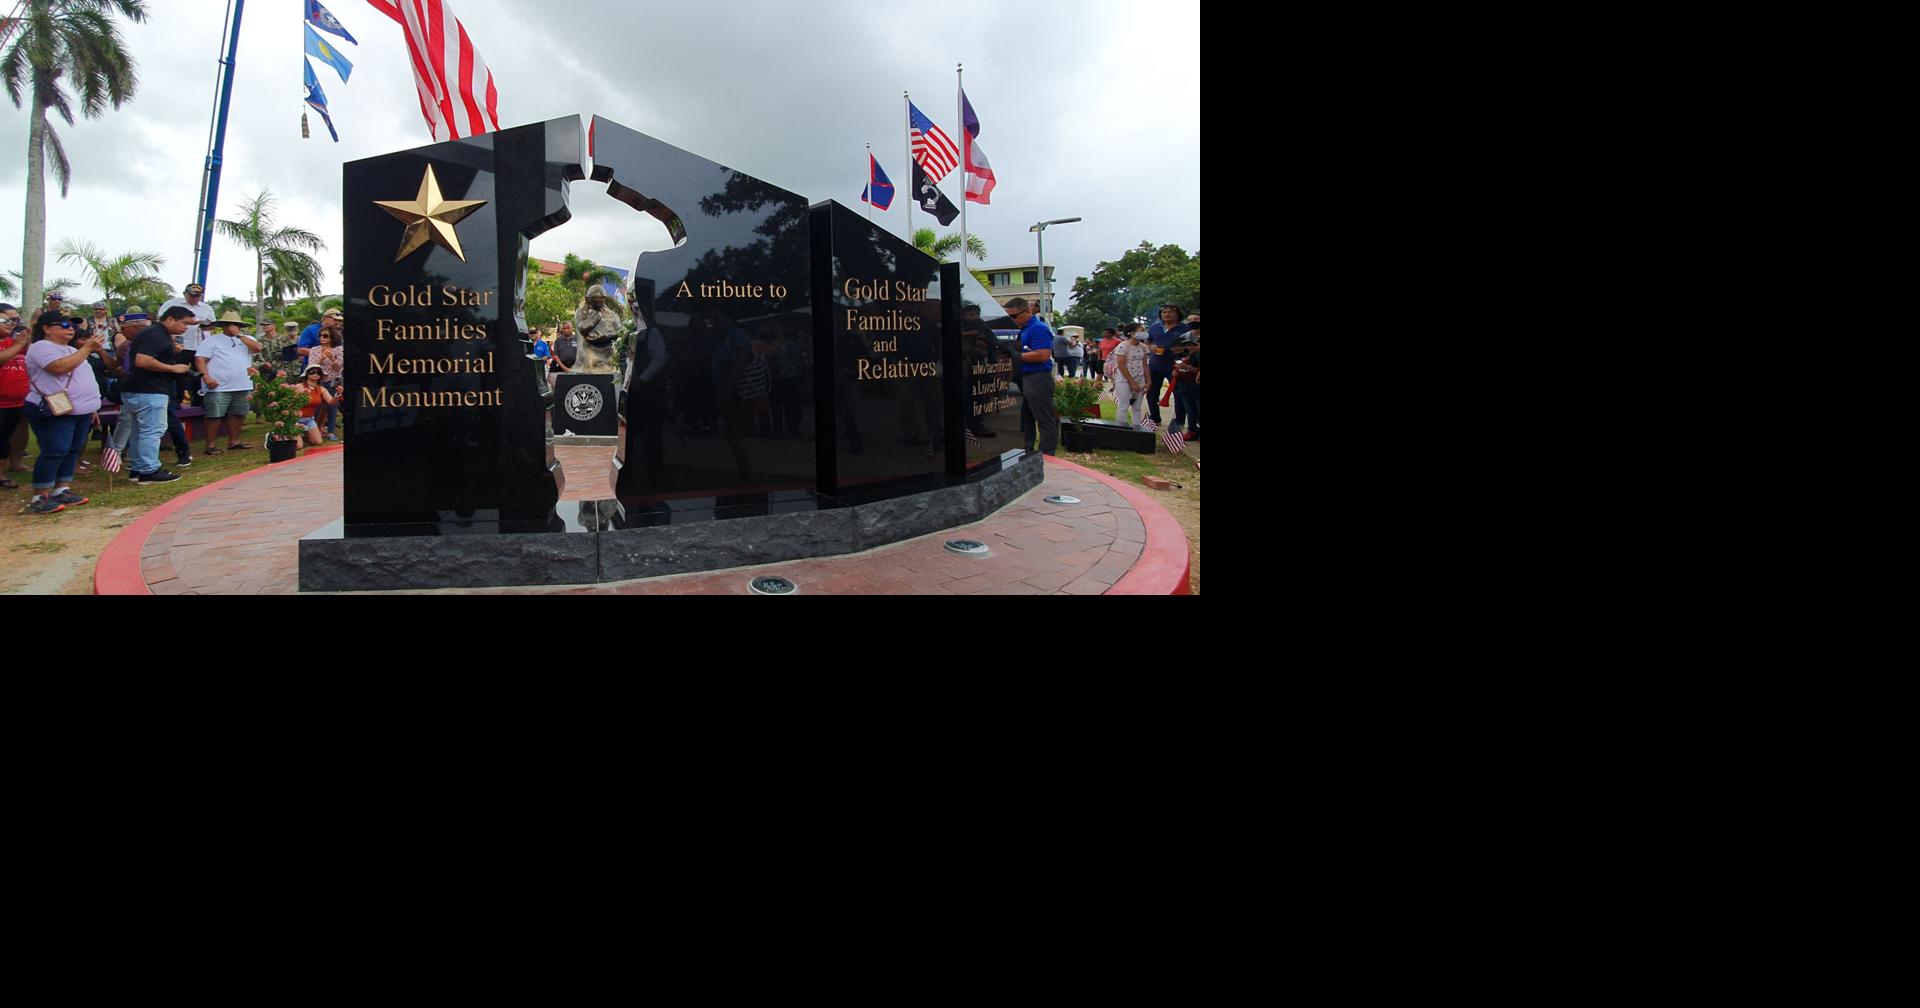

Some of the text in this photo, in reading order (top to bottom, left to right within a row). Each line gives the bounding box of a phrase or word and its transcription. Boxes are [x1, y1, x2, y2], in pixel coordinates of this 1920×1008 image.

[368, 284, 493, 307] Gold Star
[675, 280, 787, 298] A tribute to
[844, 277, 927, 302] Gold Star
[376, 318, 487, 340] Families
[846, 309, 921, 331] Families
[873, 336, 897, 352] and
[368, 352, 495, 374] Memorial
[857, 357, 937, 380] Relatives
[361, 386, 504, 408] Monument
[978, 377, 996, 395] Loved
[973, 401, 982, 416] for
[983, 401, 993, 413] our
